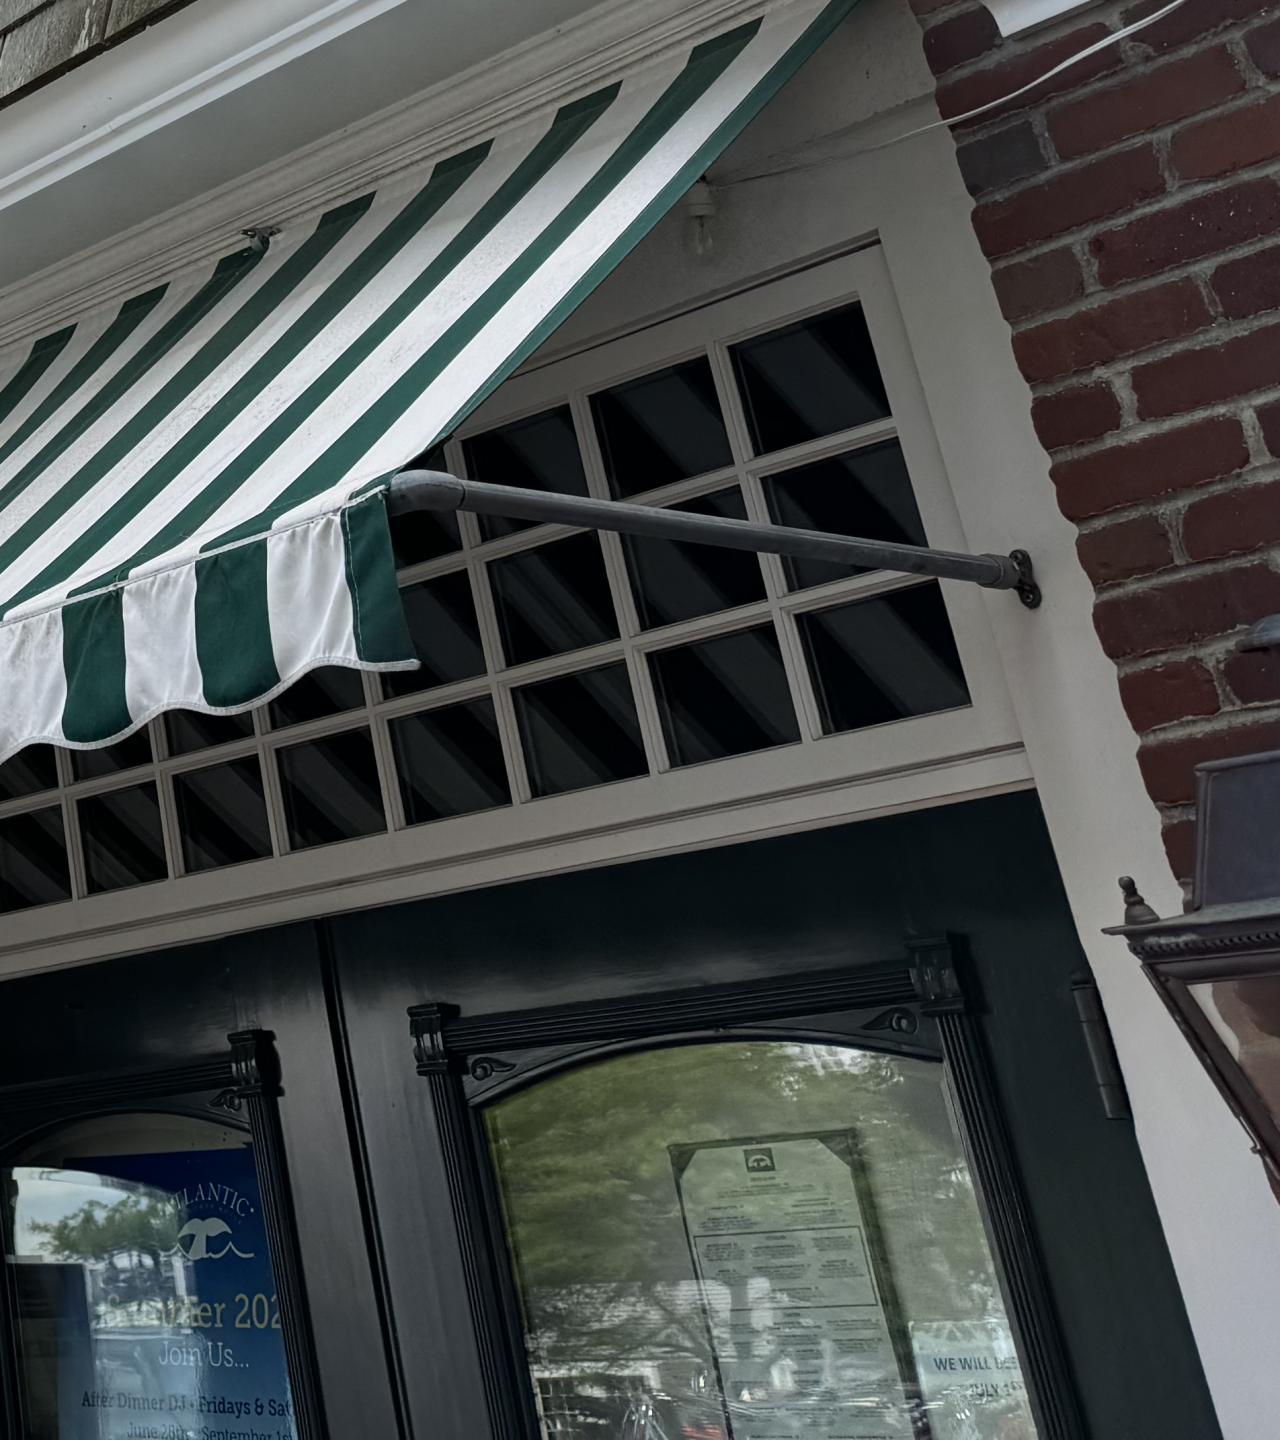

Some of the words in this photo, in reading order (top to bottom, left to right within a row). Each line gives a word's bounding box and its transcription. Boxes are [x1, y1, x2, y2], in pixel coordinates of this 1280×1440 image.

[173, 1182, 250, 1217] TLANTIC
[158, 1341, 204, 1367] Join
[933, 1357, 957, 1371] WE
[959, 1356, 993, 1371] WILL
[117, 1393, 163, 1411] Dinner
[199, 1396, 250, 1418] Fridays
[255, 1398, 265, 1416] &
